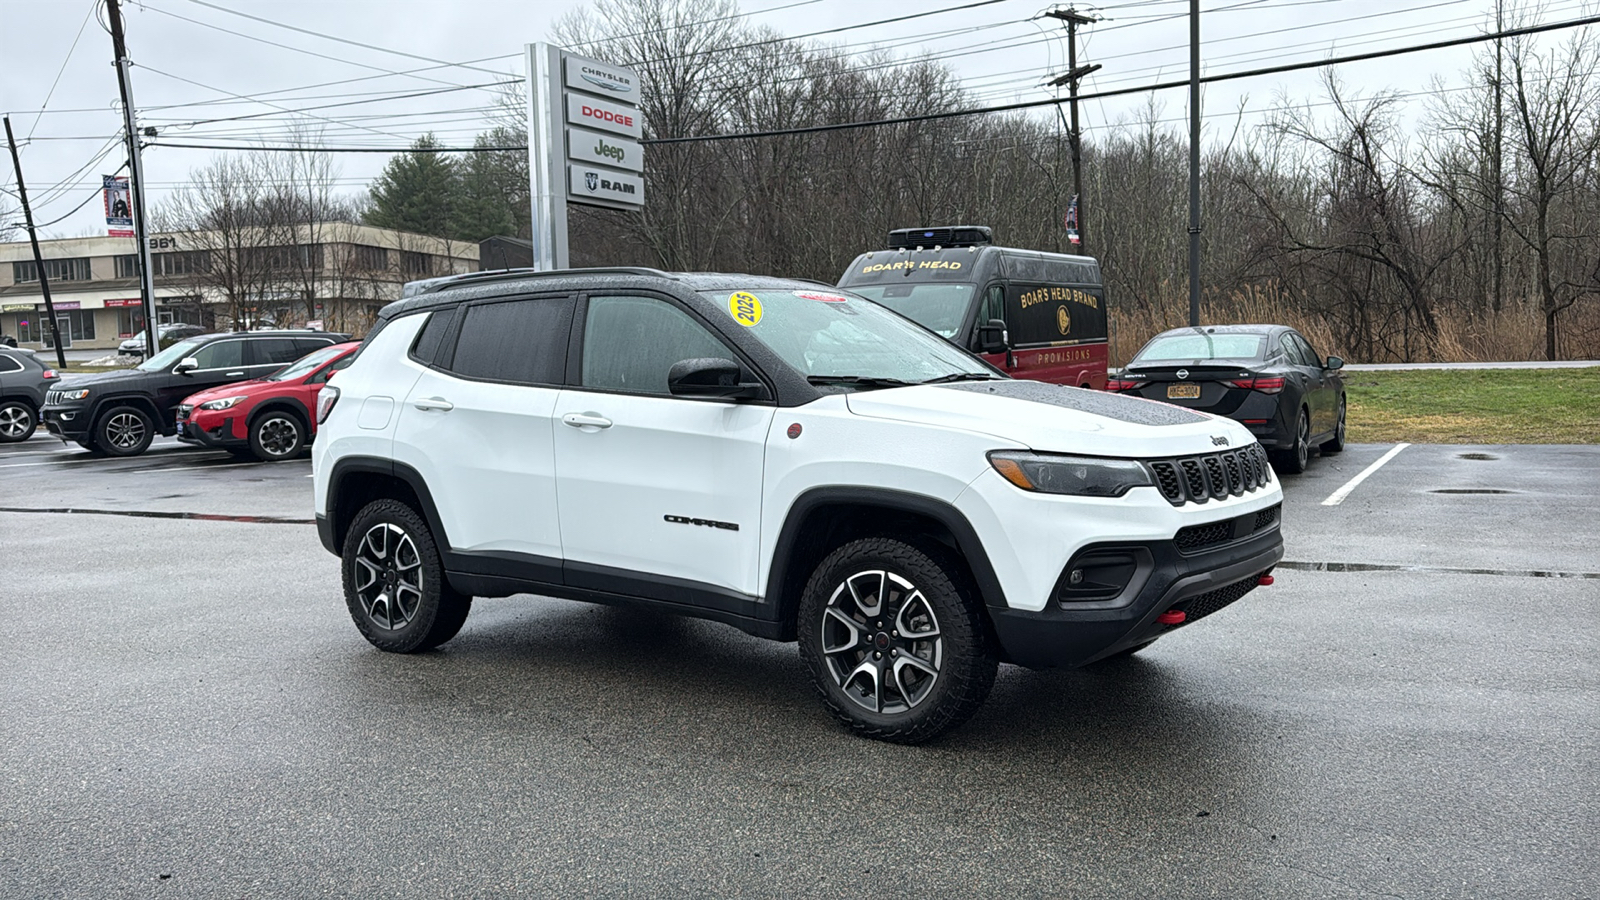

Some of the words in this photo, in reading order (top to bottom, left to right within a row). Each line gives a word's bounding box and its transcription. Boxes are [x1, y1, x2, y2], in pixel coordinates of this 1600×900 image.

[581, 66, 630, 85] CHRYSLER
[582, 106, 633, 127] DODGE
[594, 139, 625, 163] Jeep
[601, 180, 635, 194] RAM
[149, 237, 176, 249] 961
[863, 260, 915, 274] BOAR'S
[919, 260, 962, 270] HEAD
[1020, 287, 1049, 309] BOAR'S
[1051, 287, 1072, 301] HEAD
[1073, 289, 1098, 309] BRAND
[736, 293, 756, 323] 2025
[1038, 349, 1090, 364] PROVISIONS
[1210, 435, 1229, 446] Jeep
[663, 514, 740, 532] COMPASS
